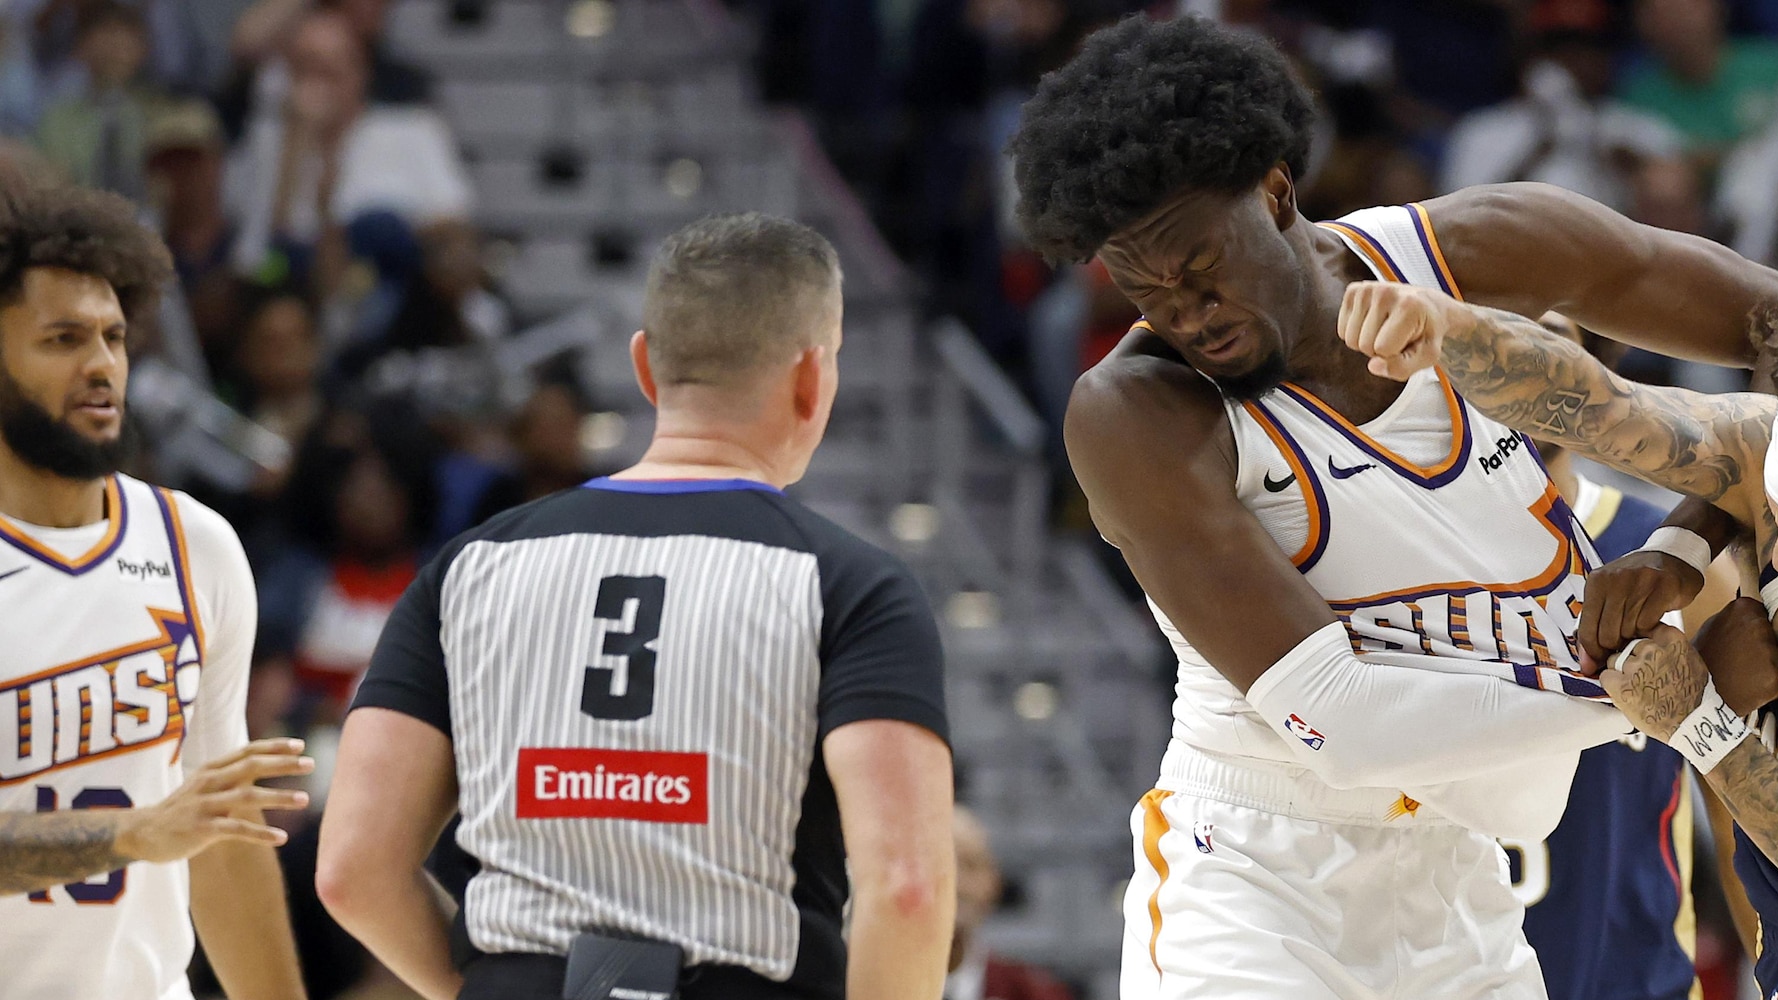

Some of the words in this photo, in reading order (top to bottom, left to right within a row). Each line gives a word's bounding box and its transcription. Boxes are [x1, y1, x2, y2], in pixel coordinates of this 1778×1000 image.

[1478, 427, 1523, 475] PaPal
[117, 558, 171, 581] PayPal
[580, 574, 666, 721] 3
[0, 649, 168, 780] UNS
[534, 764, 691, 805] Emirates
